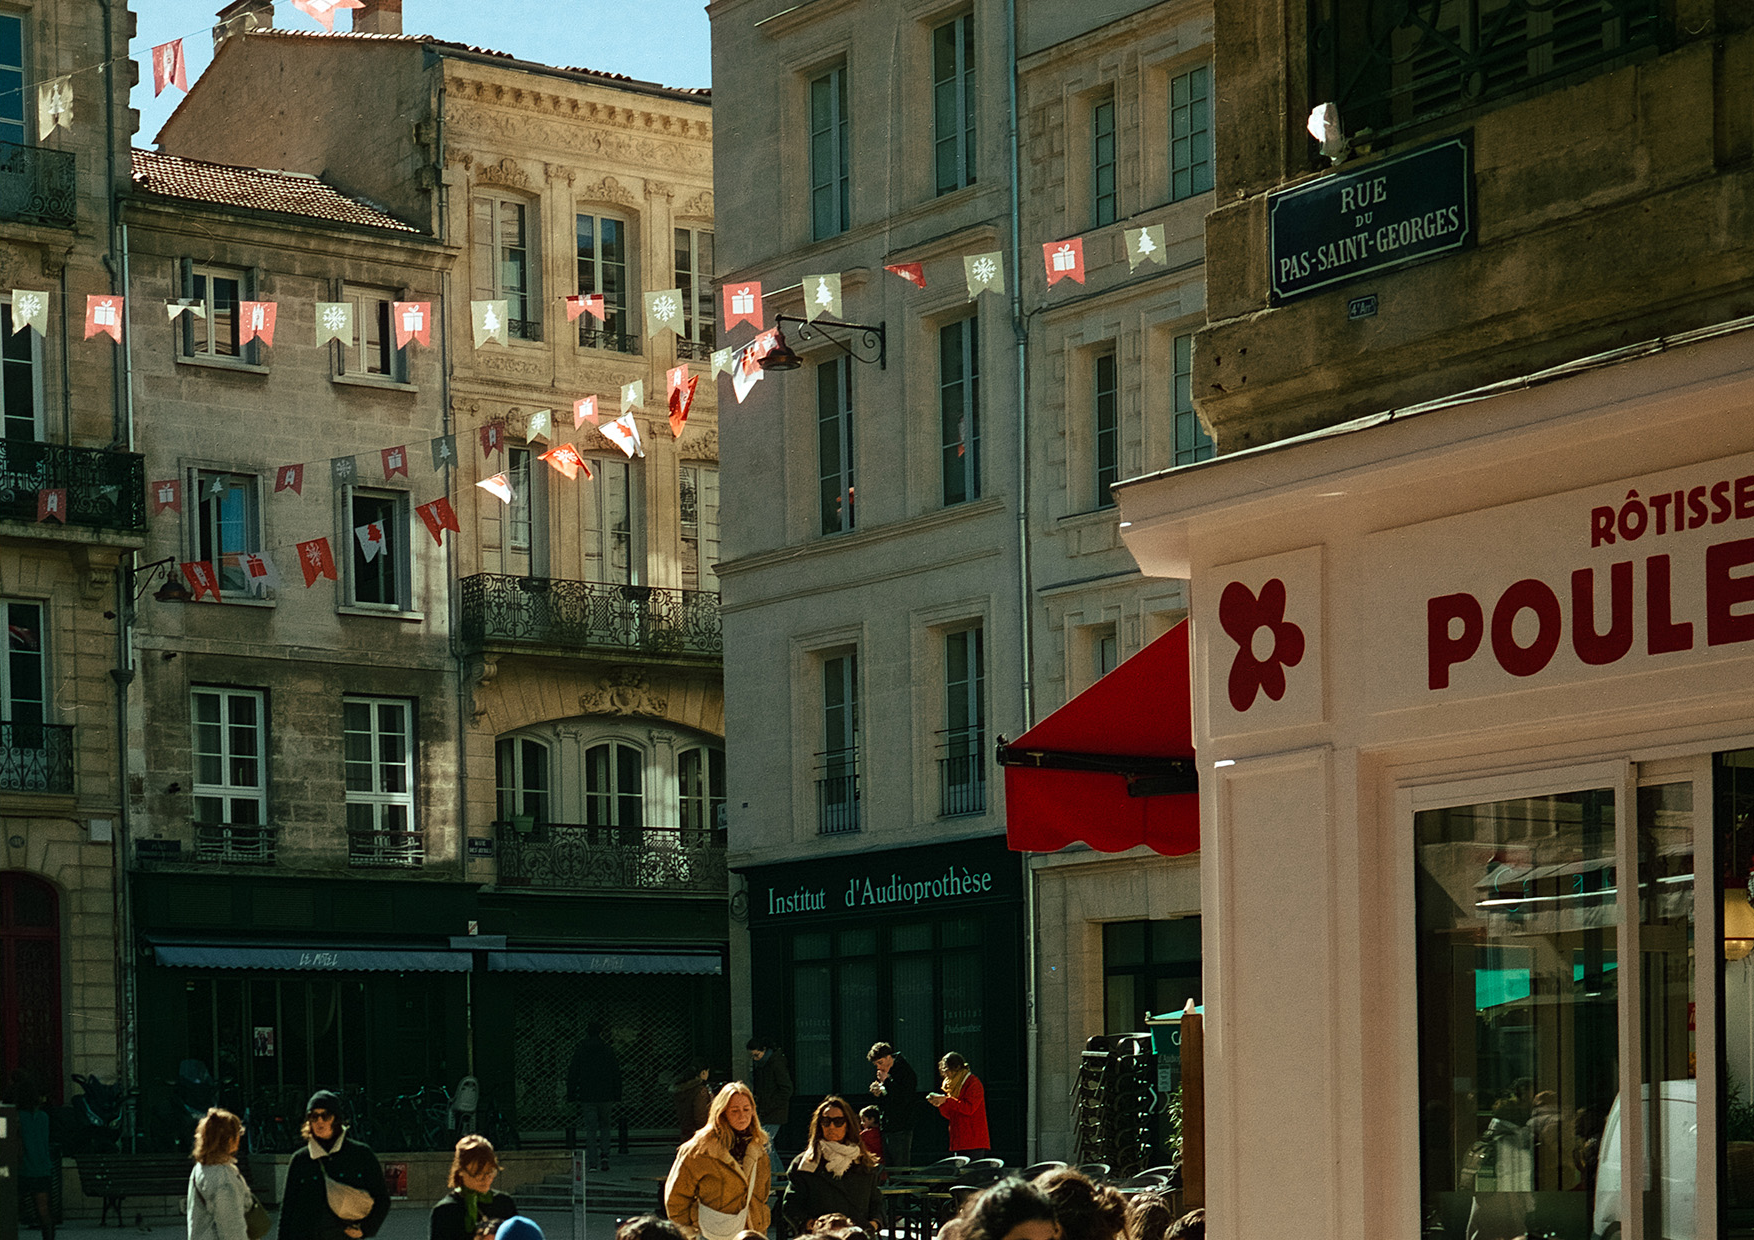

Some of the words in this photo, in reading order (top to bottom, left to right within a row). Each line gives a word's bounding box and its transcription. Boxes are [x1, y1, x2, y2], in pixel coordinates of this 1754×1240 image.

[1340, 176, 1387, 213] RUE
[1355, 211, 1373, 228] DU
[1279, 205, 1460, 283] PAS-SAINT-GEORGES
[1591, 475, 1754, 548] RÔTISSE
[1427, 537, 1754, 690] POULE
[768, 885, 826, 915] Institut
[845, 865, 992, 907] d'Audioprothèse
